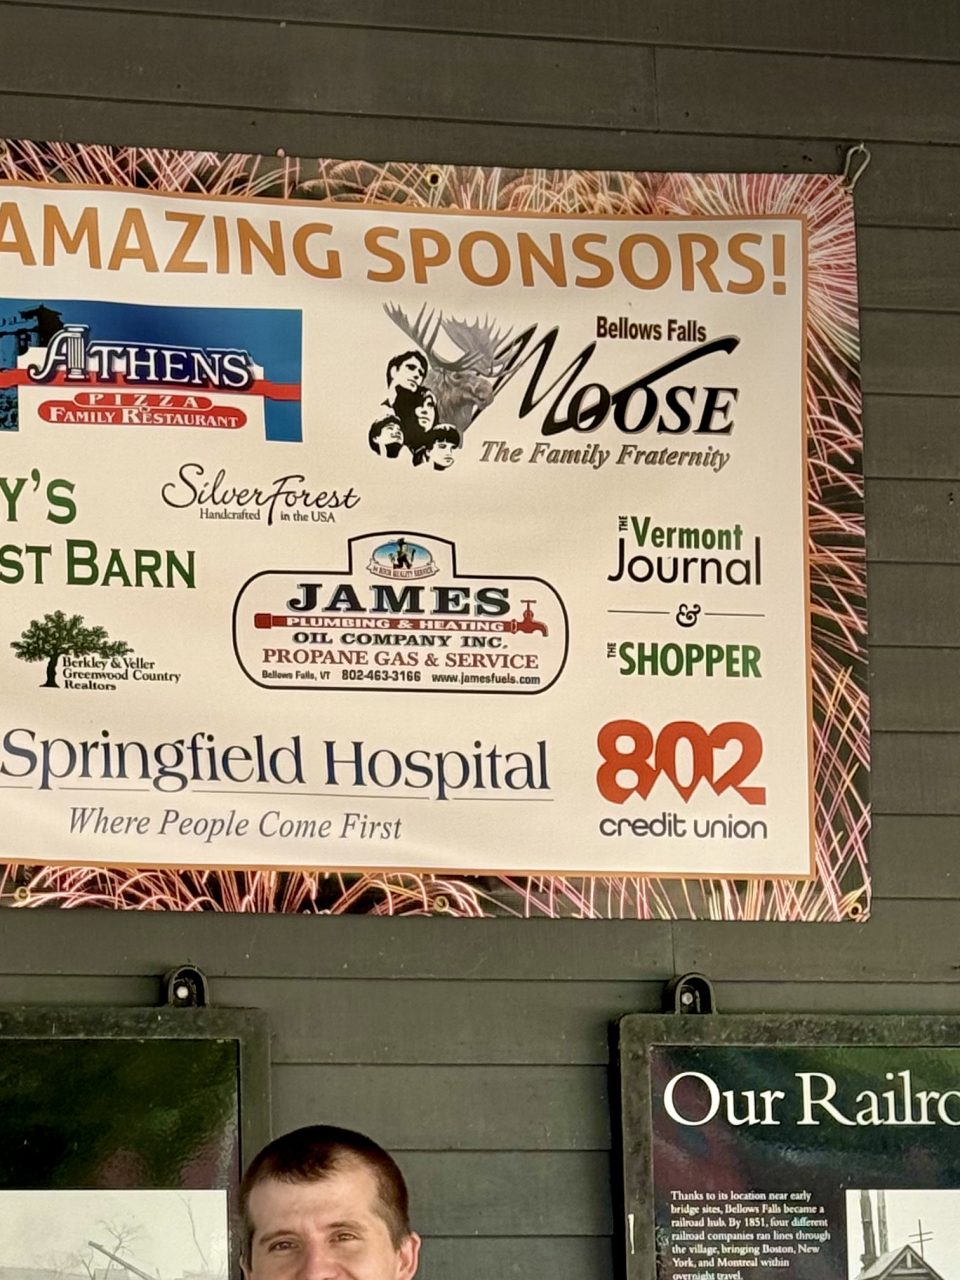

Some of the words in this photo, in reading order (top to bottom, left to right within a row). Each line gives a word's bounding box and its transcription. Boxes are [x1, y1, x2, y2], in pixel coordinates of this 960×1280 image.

[364, 226, 787, 295] SPONSORS!
[596, 316, 662, 341] Bellows
[667, 319, 707, 342] Falls
[29, 324, 249, 387] ATHENS
[493, 323, 740, 436] MOOSE
[90, 394, 199, 408] PIZZA
[50, 407, 116, 422] FAMILY
[122, 408, 238, 427] RESTAURANT
[480, 441, 524, 463] The
[529, 443, 610, 469] Family
[616, 444, 730, 473] Fraternity
[200, 508, 260, 520] Handcrafted
[280, 511, 290, 521] in
[293, 511, 308, 522] the
[311, 511, 335, 523] USA
[618, 515, 628, 532] THE
[631, 516, 743, 550] Vermont
[65, 539, 197, 589] BARN
[607, 536, 761, 585] Journal
[287, 583, 511, 617] JAMES
[286, 617, 390, 629] PLUMBING
[397, 620, 414, 629] &
[419, 621, 506, 632] HEATING
[676, 603, 701, 627] &
[292, 632, 333, 644] OIL
[340, 633, 451, 647] COMPANY
[460, 637, 509, 649] INC.
[63, 657, 108, 670] Berkley
[111, 658, 122, 668] &
[123, 658, 155, 669] Veller
[262, 649, 368, 665] PROPANE
[375, 650, 418, 666] GAS
[424, 652, 440, 667] &
[445, 653, 539, 669] SERVICE
[607, 642, 616, 658] THE
[619, 641, 762, 678] SHOPPER
[63, 668, 128, 680] Greenwood
[132, 670, 181, 684] Country
[64, 680, 116, 690] Realtors
[262, 670, 293, 679] Bellows
[319, 671, 331, 679] VT
[342, 670, 421, 682] 802-463-3166
[432, 672, 541, 685] www.jamesfuels.com
[0, 728, 306, 792] Springfield
[323, 740, 551, 800] Hospital
[596, 719, 766, 806] 802
[69, 806, 150, 834] Where
[157, 809, 249, 843] People
[258, 811, 332, 839] Come
[339, 813, 402, 840] First
[599, 812, 687, 837] credit
[693, 814, 768, 839] union
[664, 1071, 785, 1126] Our
[671, 1191, 704, 1200] Thanks
[706, 1192, 715, 1200] to
[718, 1191, 728, 1200] its
[731, 1191, 766, 1200] location
[790, 1191, 811, 1203] early
[671, 1204, 700, 1216] bridge
[702, 1205, 723, 1214] sites,
[725, 1204, 760, 1214] Bellows
[762, 1204, 781, 1213] Falls
[783, 1204, 817, 1213] became
